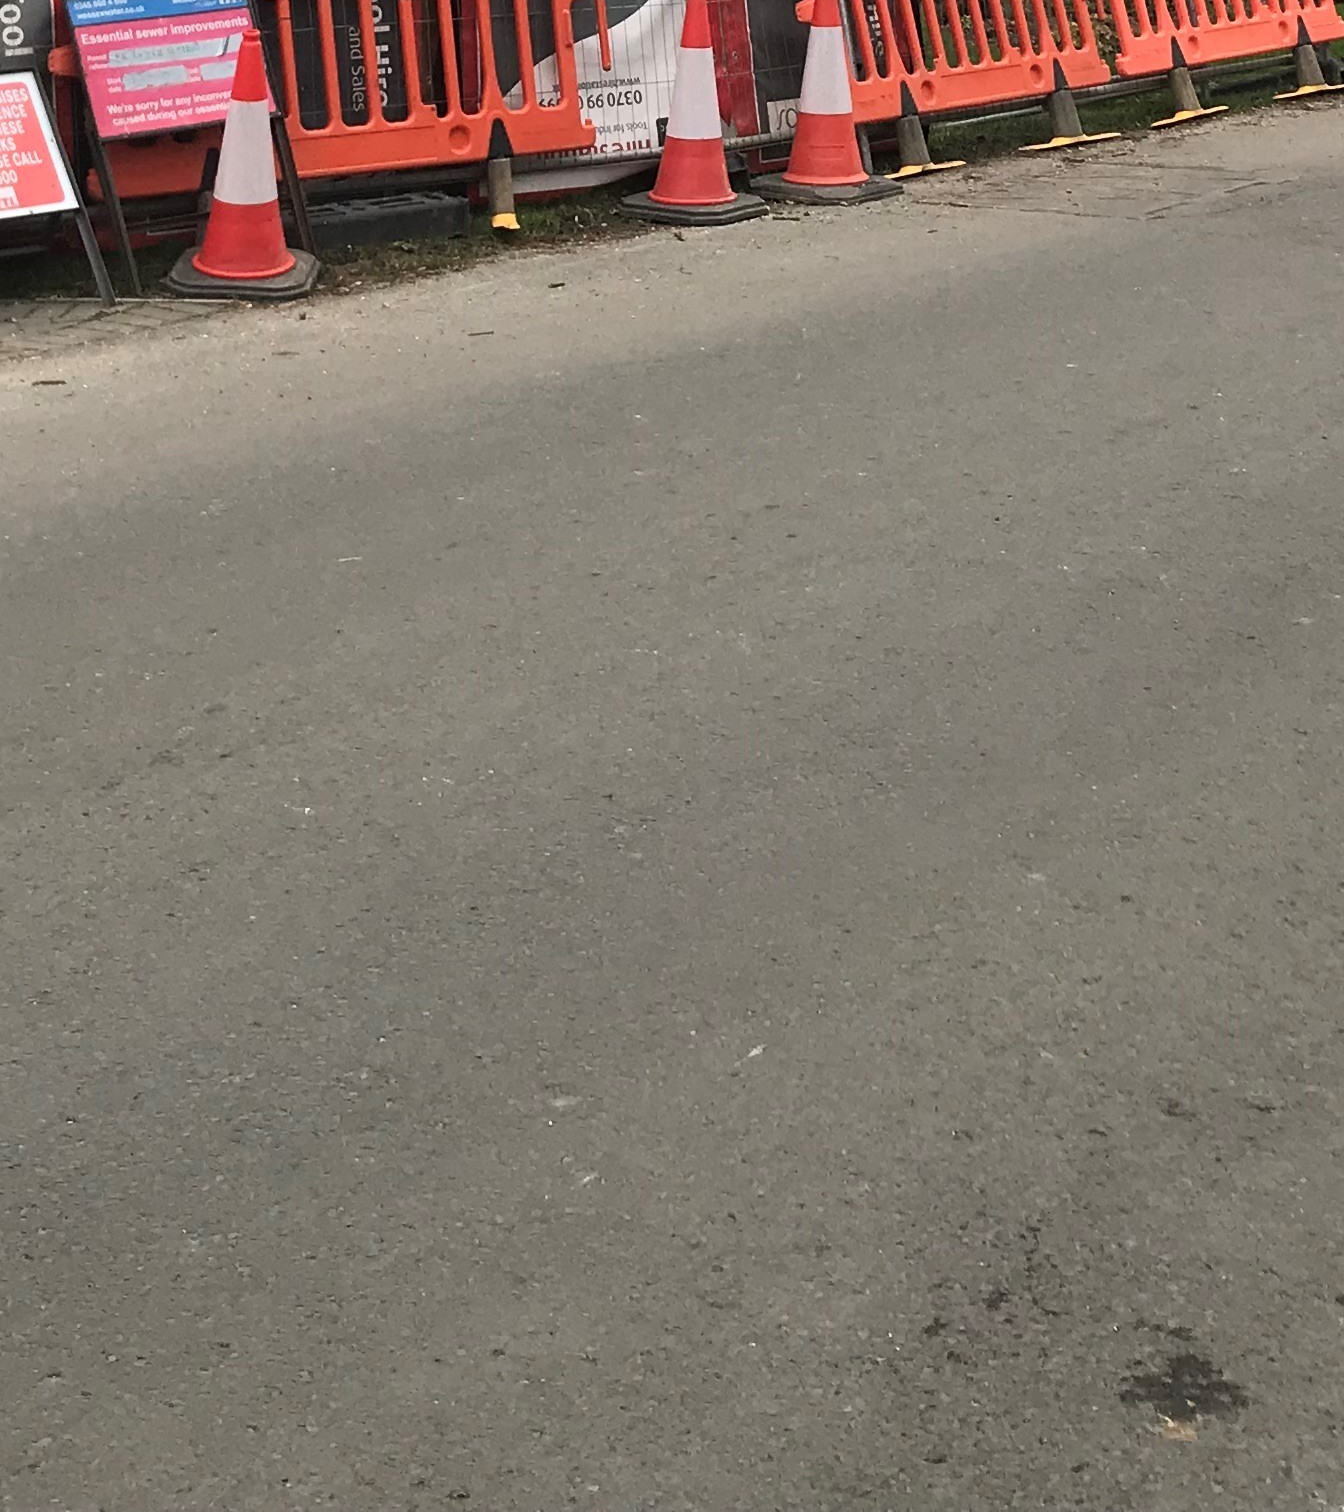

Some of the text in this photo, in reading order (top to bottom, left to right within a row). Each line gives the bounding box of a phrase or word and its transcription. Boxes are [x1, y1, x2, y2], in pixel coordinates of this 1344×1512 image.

[80, 15, 249, 45] Essential sewer improvements
[349, 26, 366, 112] and Sales
[107, 103, 134, 115] We're
[136, 99, 159, 111] sorry
[160, 97, 173, 107] for
[175, 94, 191, 106] any
[587, 94, 604, 109] 99
[607, 89, 643, 108] 0370
[113, 113, 146, 127] caused
[147, 109, 177, 123] during
[178, 106, 194, 117] our
[12, 150, 43, 166] CALL
